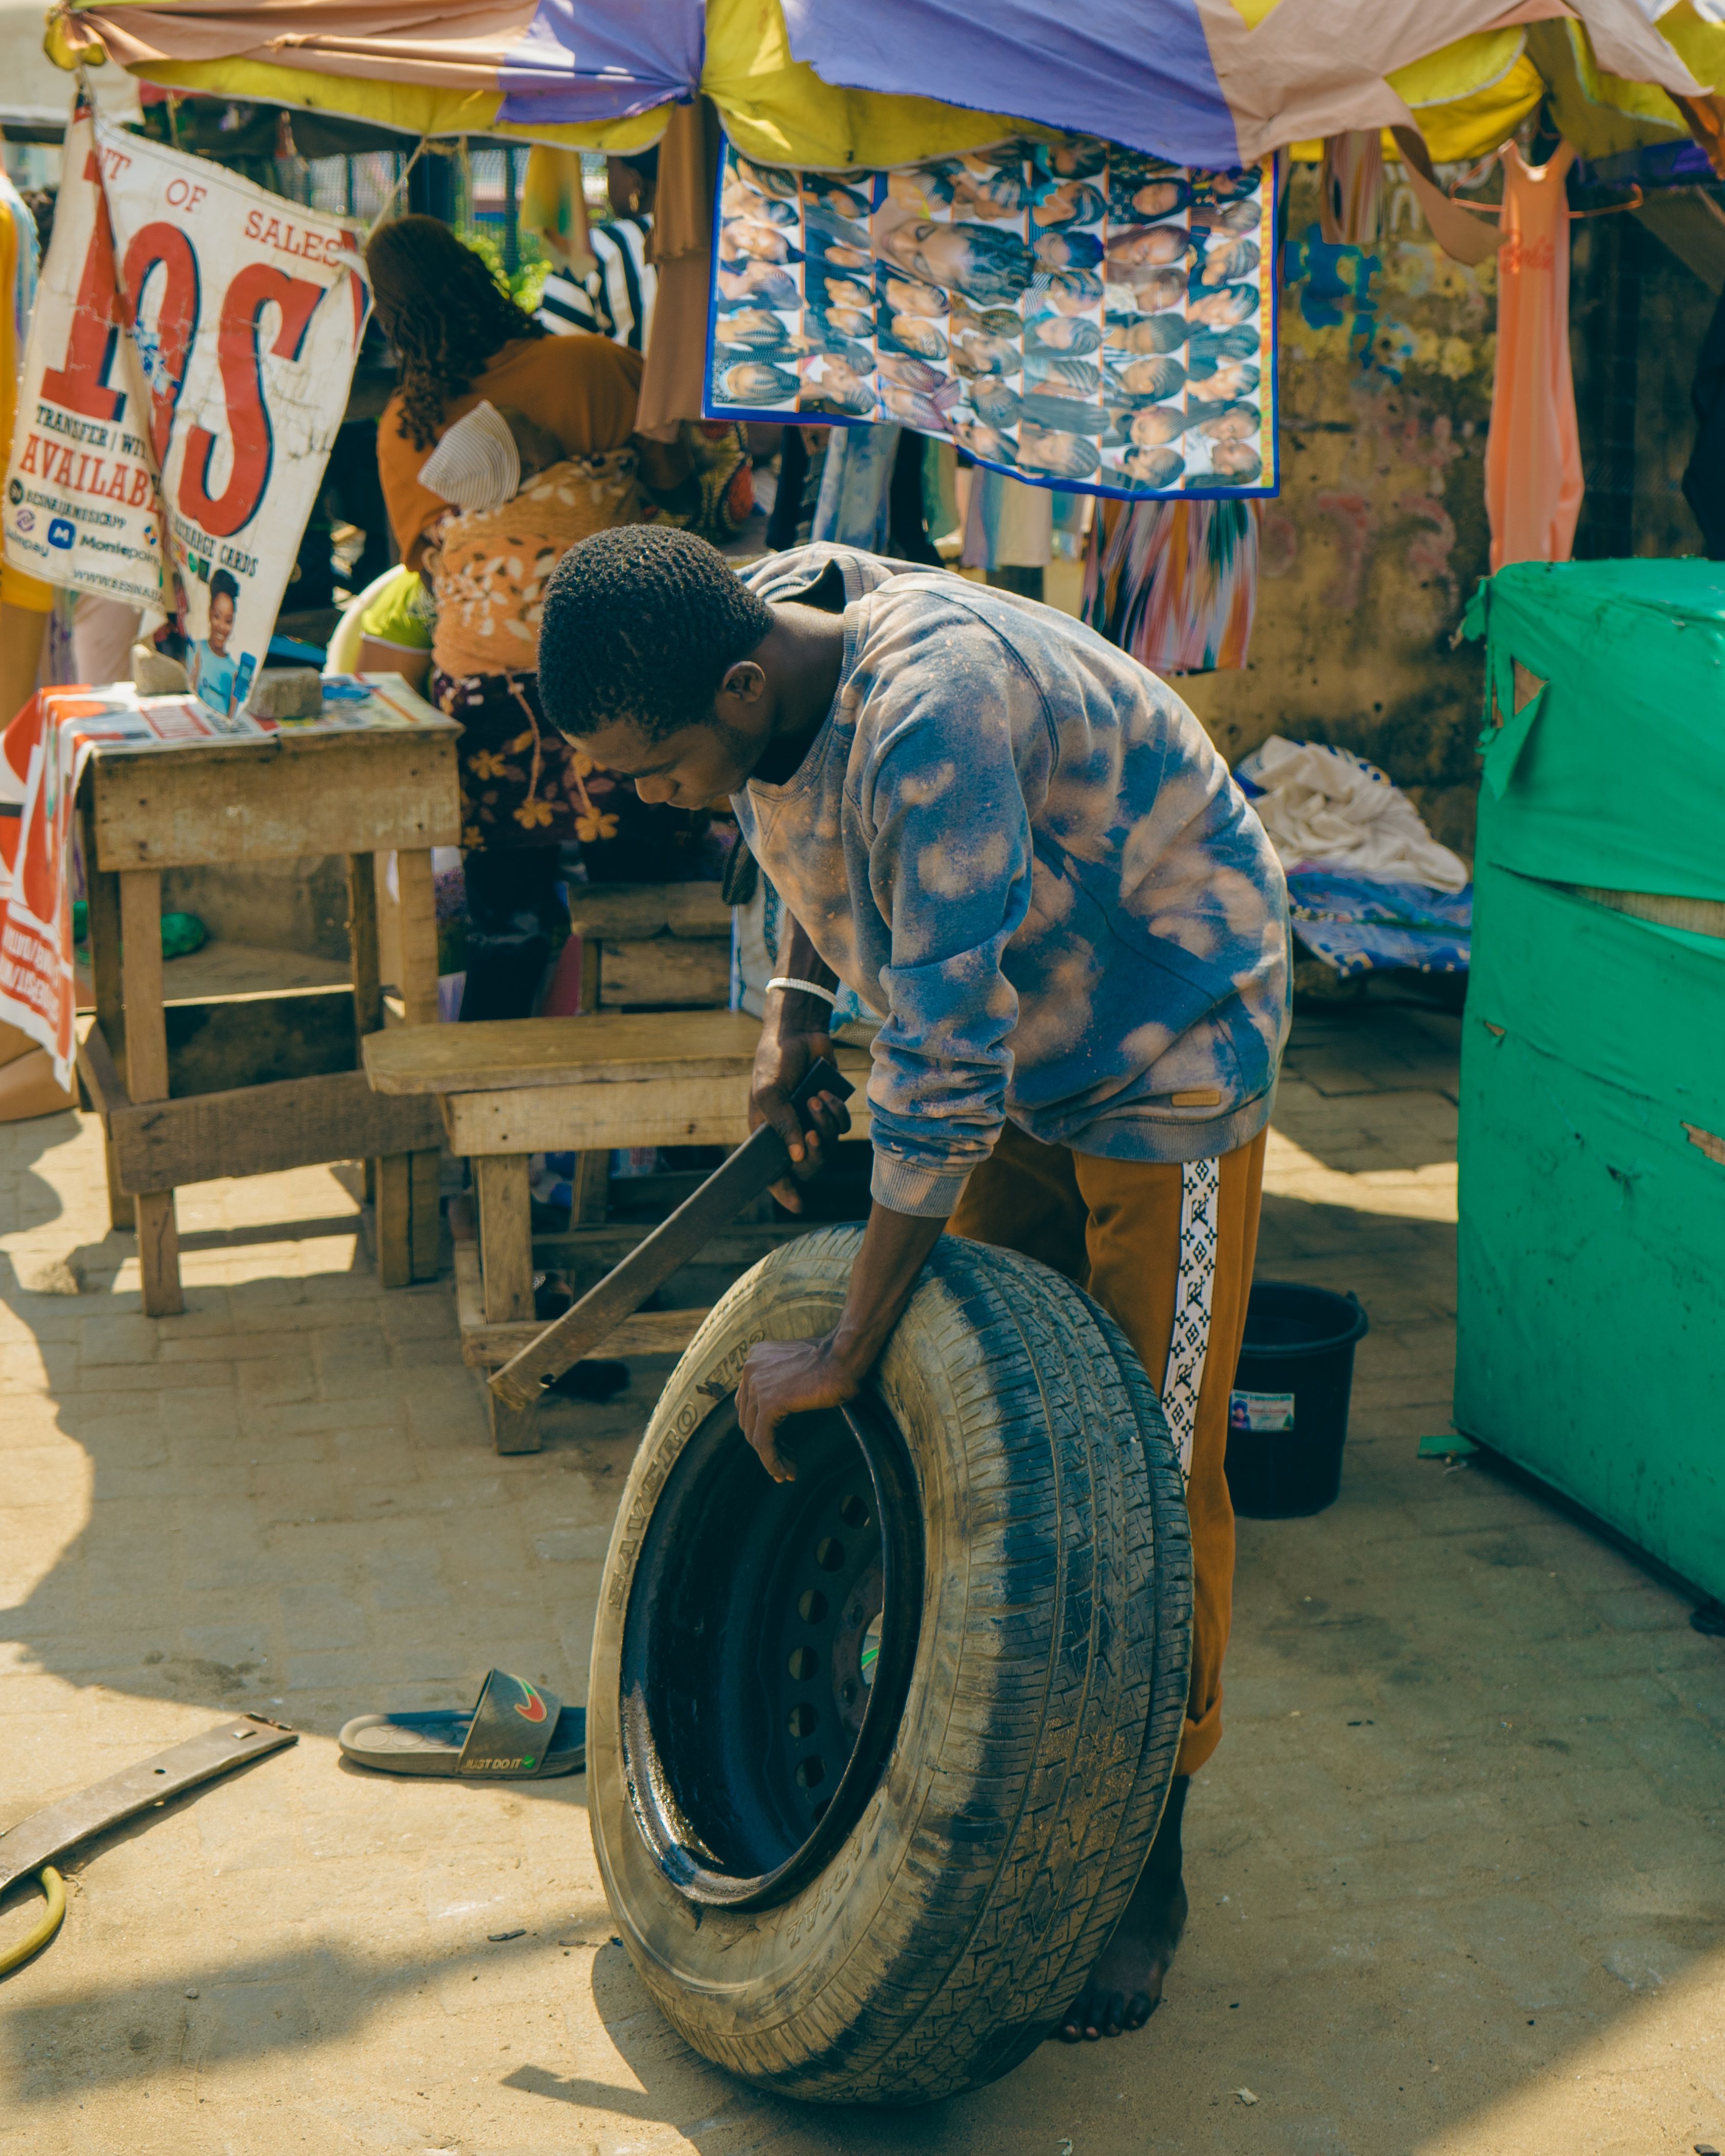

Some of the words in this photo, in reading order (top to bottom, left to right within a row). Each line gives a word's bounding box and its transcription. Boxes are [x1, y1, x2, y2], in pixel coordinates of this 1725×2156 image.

[166, 177, 208, 213] OF
[244, 208, 343, 268] SALES
[36, 404, 109, 448] TRANSFER
[220, 543, 259, 577] CARDS
[609, 1401, 698, 1609] SAVERO
[492, 1758, 510, 1770] DO
[511, 1758, 523, 1769] IT
